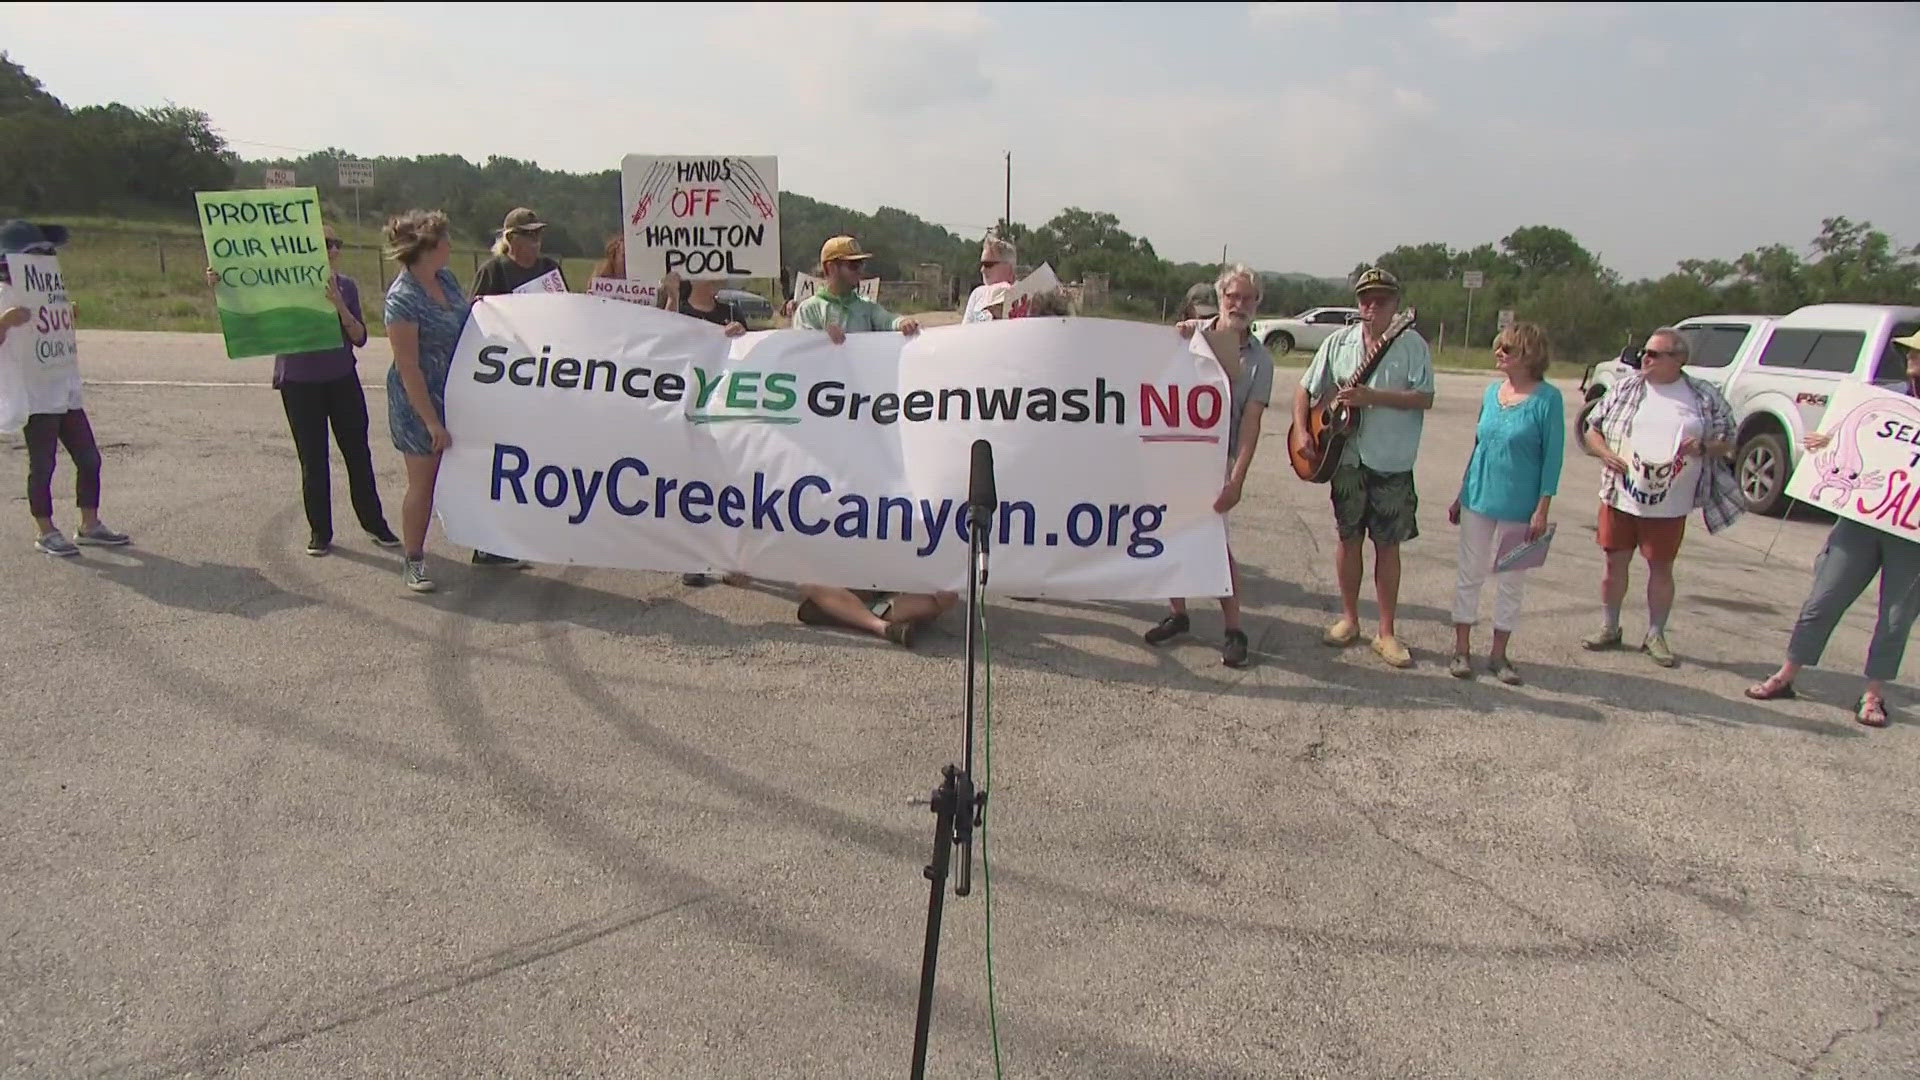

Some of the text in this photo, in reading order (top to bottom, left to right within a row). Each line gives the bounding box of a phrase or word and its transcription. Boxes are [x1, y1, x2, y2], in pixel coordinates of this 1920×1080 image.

[274, 171, 287, 179] NO
[677, 158, 730, 182] HANDS
[204, 199, 314, 225] PROTECT
[671, 188, 721, 218] OFF
[213, 235, 318, 258] OUR HILL
[646, 224, 764, 247] HAMILTON
[665, 250, 752, 275] POOL
[222, 265, 325, 287] COUNTRY
[595, 282, 656, 296] NO ALGAE
[807, 377, 1126, 425] Greenwash
[1140, 382, 1222, 430] NO
[490, 443, 1167, 559] RoyCreekCanyon.org
